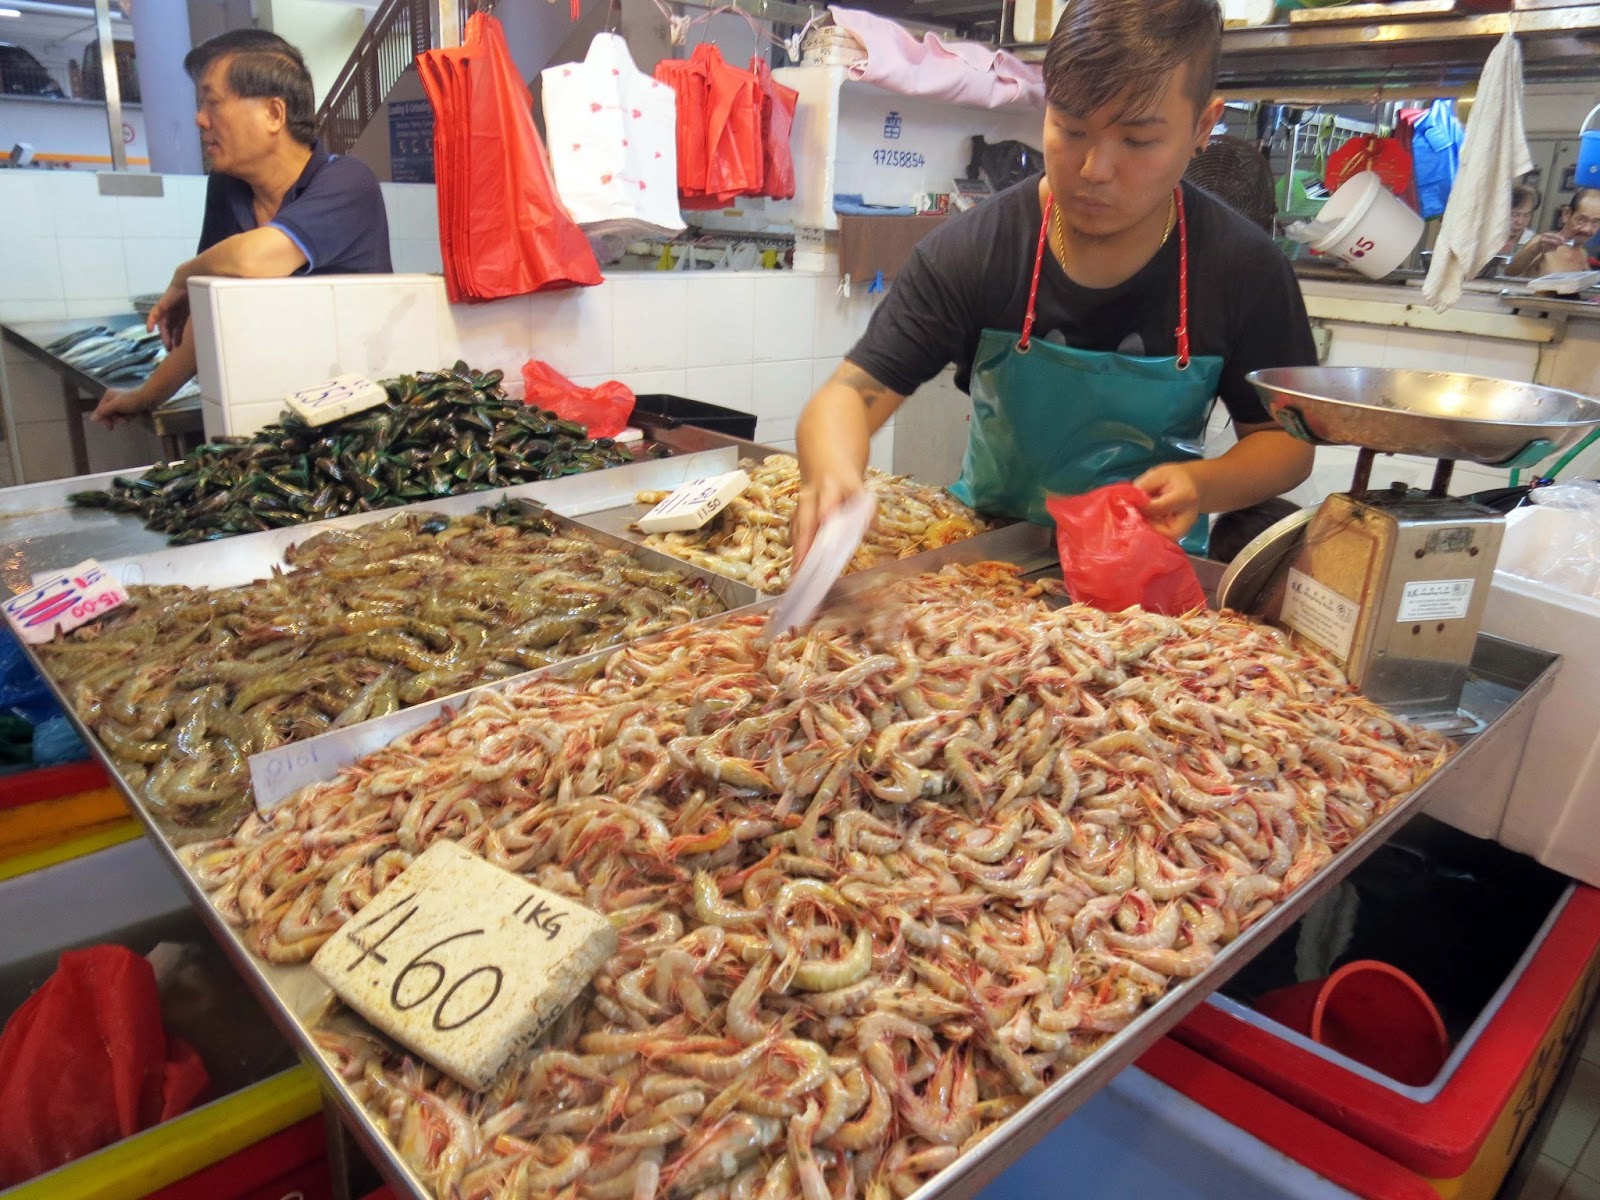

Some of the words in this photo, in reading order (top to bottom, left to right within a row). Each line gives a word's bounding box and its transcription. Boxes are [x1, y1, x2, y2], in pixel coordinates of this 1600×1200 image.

[873, 149, 925, 168] 97258854
[697, 498, 722, 520] 11.50
[346, 892, 503, 1032] 4.60
